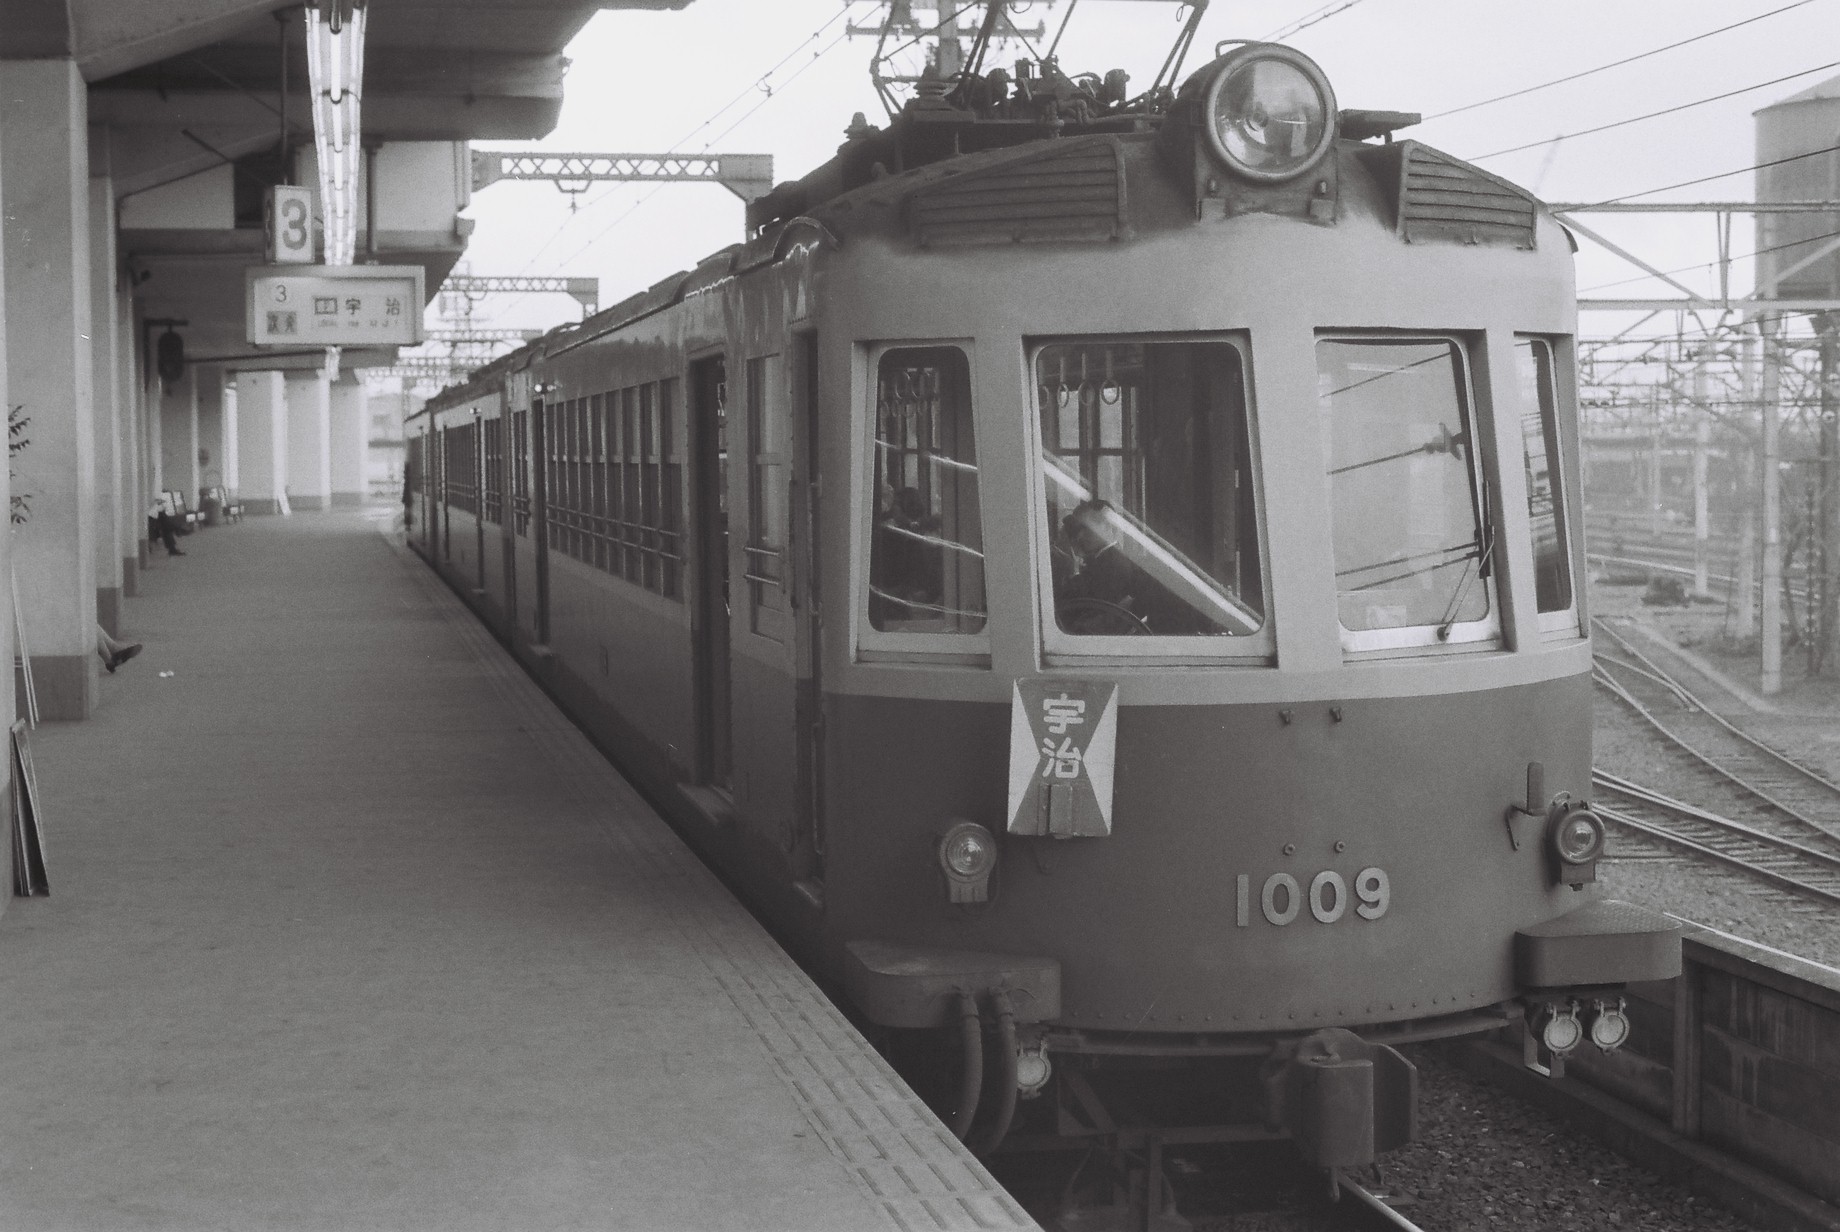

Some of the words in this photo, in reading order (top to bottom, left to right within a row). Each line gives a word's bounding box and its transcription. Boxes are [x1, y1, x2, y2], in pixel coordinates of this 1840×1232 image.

[281, 198, 308, 250] 3
[275, 284, 287, 302] 3
[1042, 693, 1086, 779] 宇治
[1237, 867, 1390, 927] 1009
